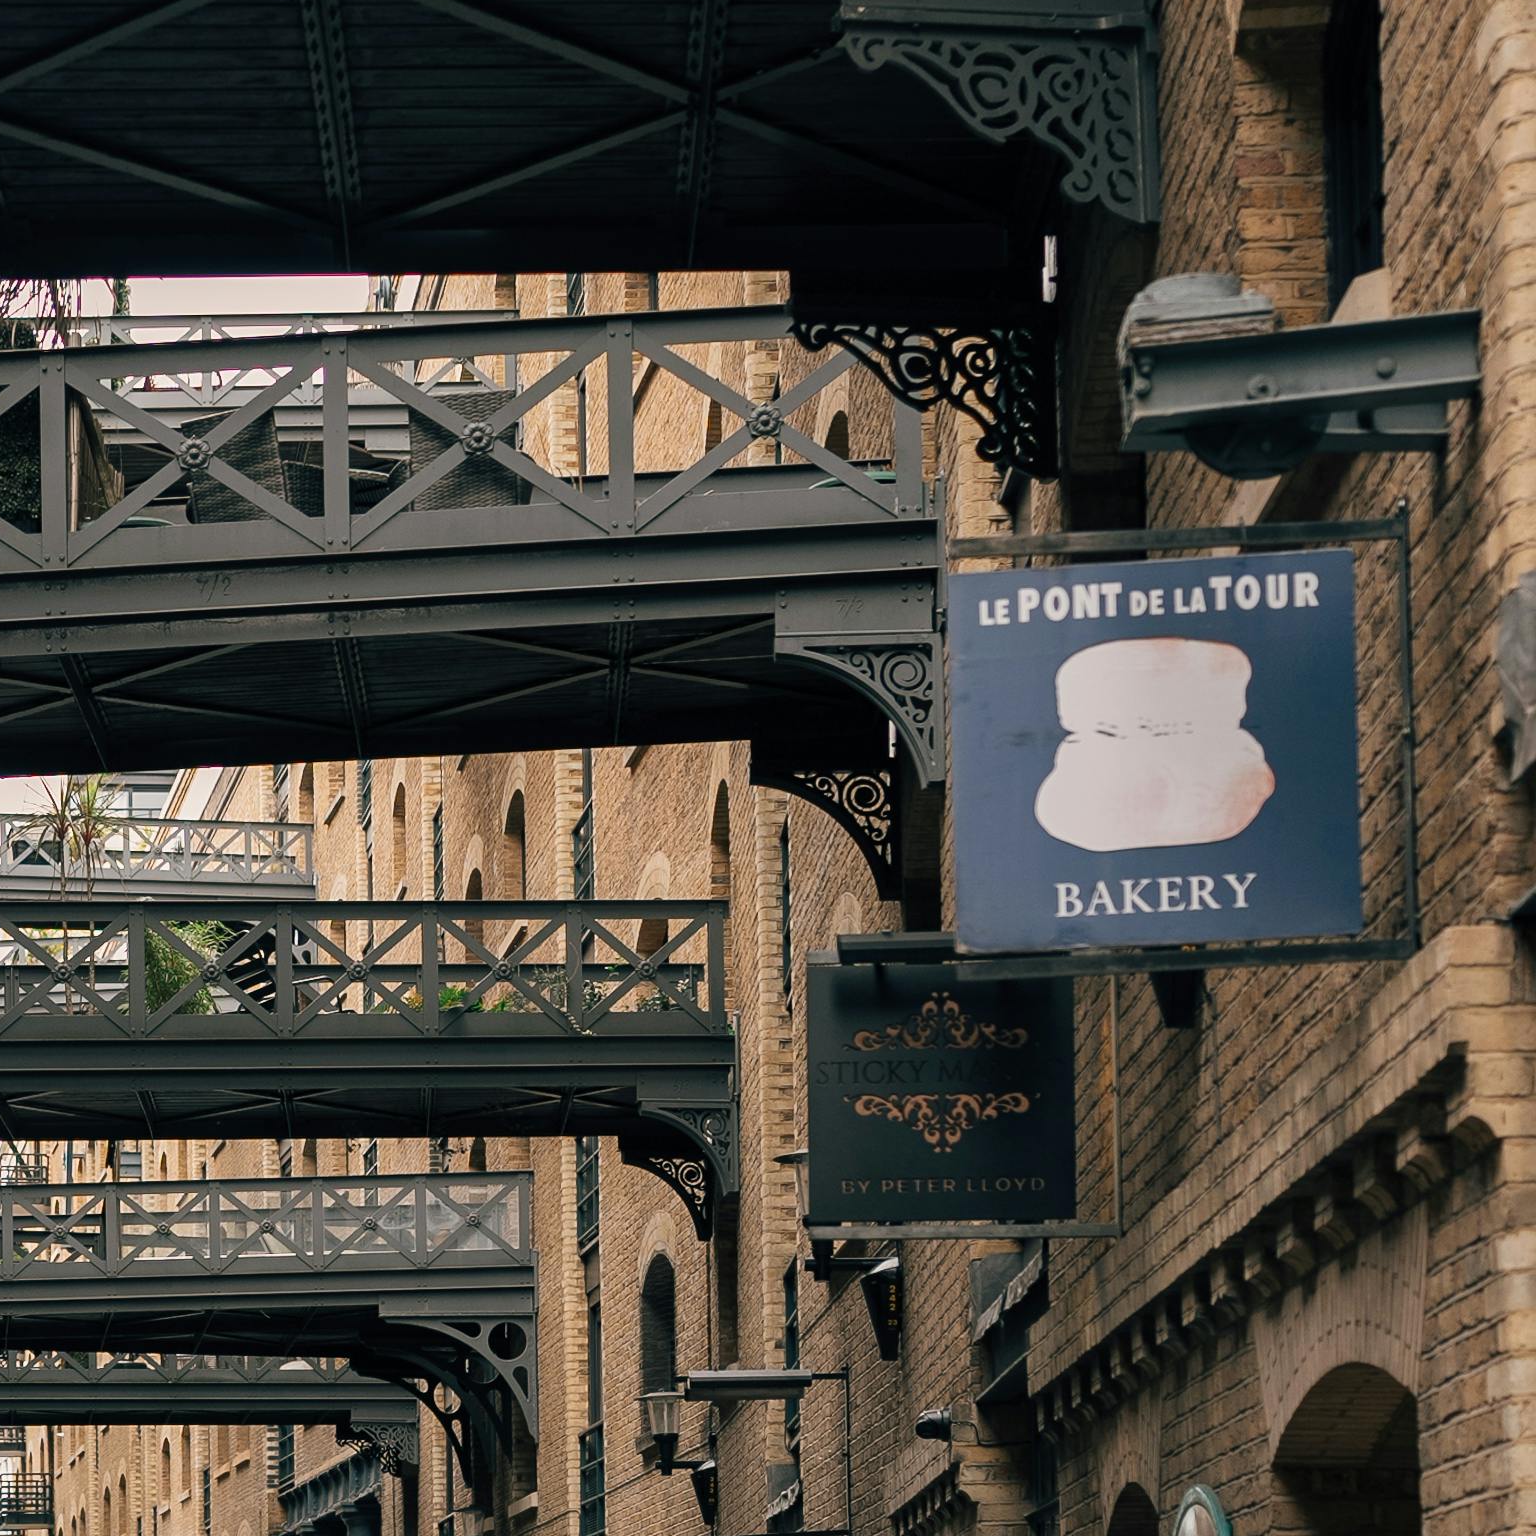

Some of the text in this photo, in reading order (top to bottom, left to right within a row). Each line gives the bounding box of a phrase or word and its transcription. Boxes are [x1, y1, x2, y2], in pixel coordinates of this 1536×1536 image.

[978, 571, 1320, 626] LE PONT DE LA TOUR
[1053, 871, 1258, 919] BAKERY
[815, 1060, 929, 1085] STICKY
[841, 1177, 1046, 1195] BY PETER LLOYD
